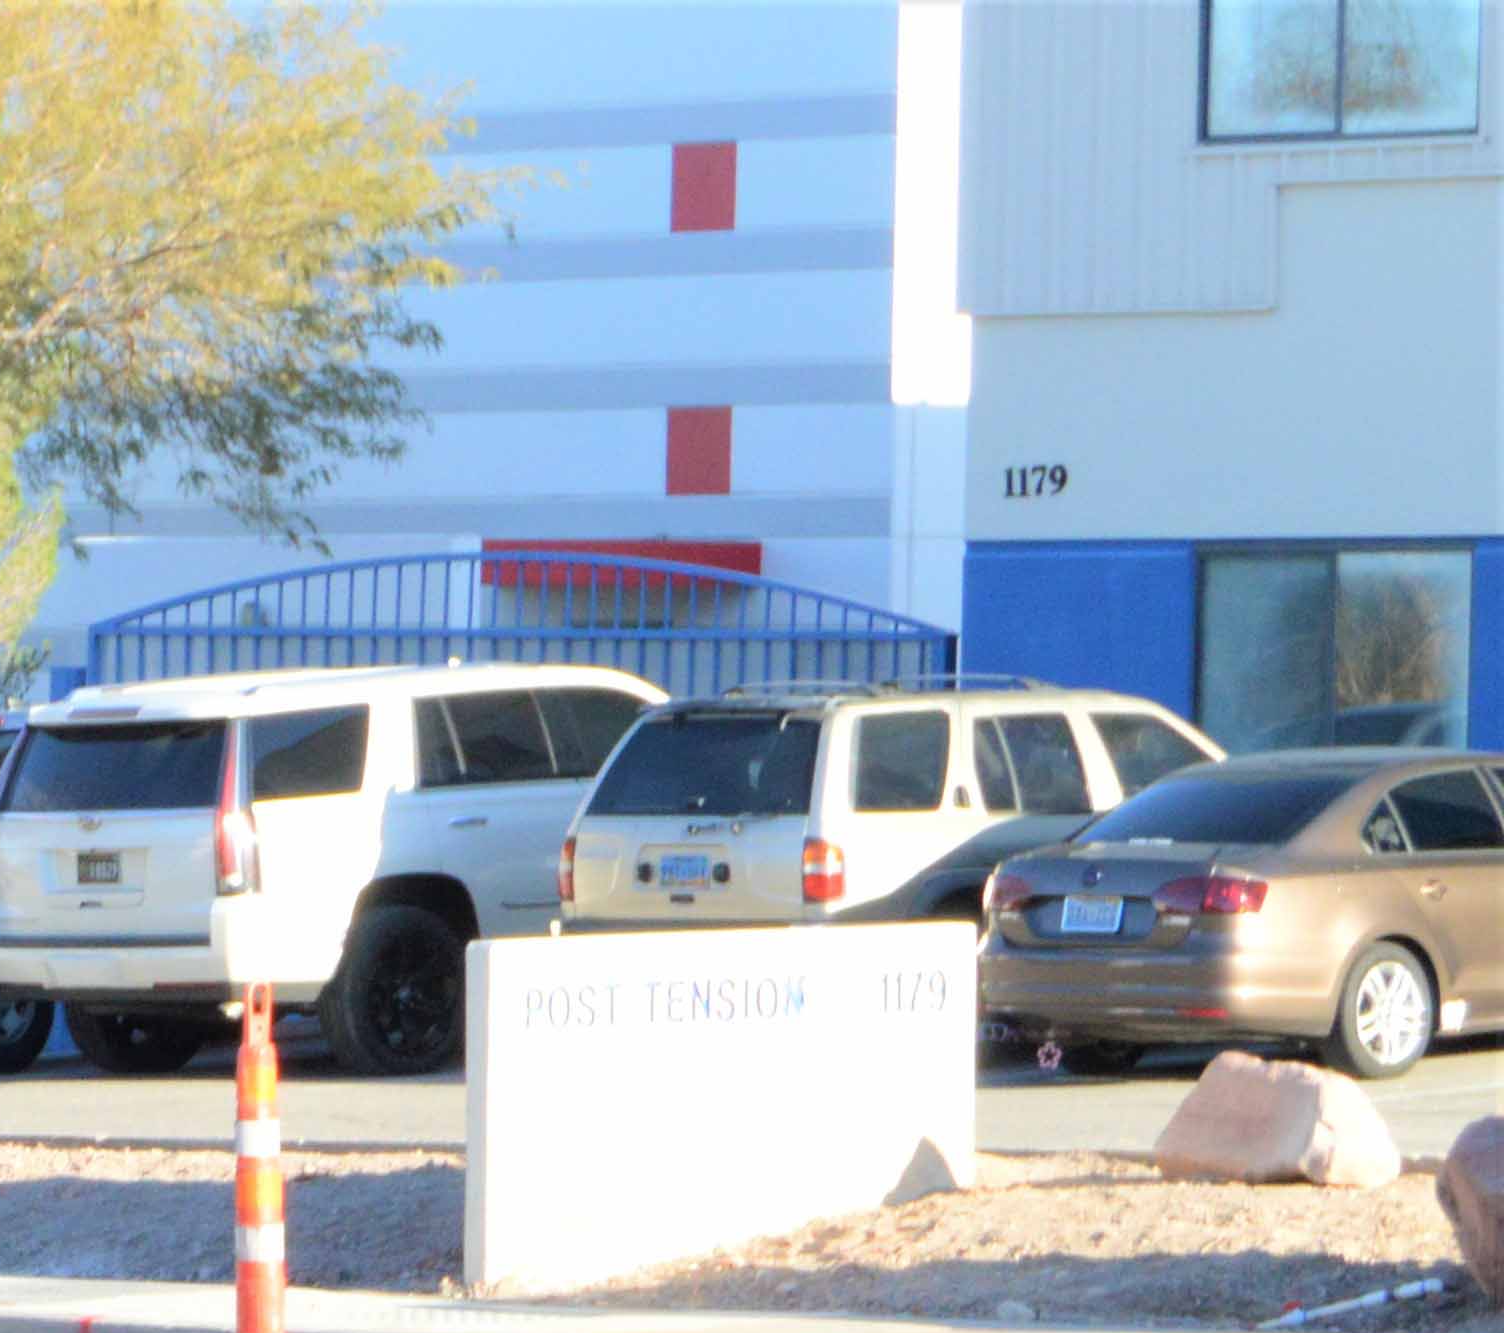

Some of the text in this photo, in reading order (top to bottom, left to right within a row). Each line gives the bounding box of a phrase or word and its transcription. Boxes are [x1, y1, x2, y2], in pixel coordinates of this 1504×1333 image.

[1004, 464, 1068, 498] 1179
[525, 968, 949, 1029] POST TENSION 1179
